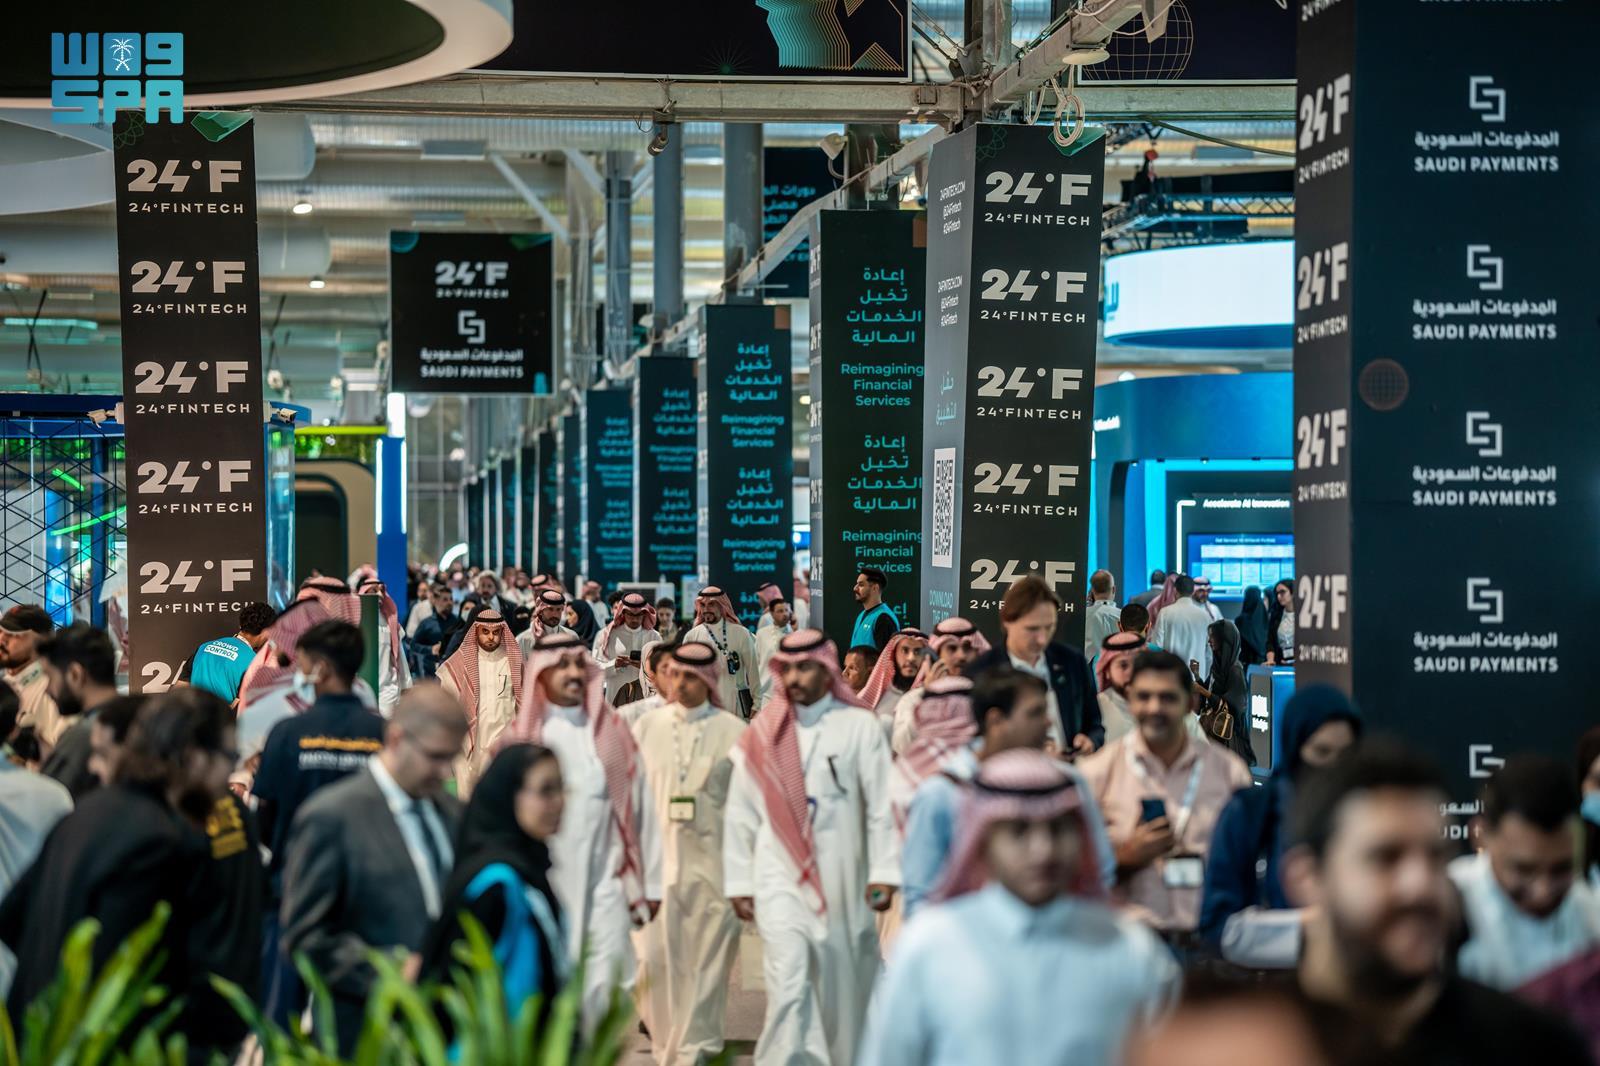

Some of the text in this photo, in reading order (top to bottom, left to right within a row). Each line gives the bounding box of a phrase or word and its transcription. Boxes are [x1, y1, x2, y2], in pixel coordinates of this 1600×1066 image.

[1299, 73, 1351, 150] 24°F
[1414, 131, 1559, 150] المدفوعات السعودية
[1414, 156, 1559, 172] SAUDI PAYMENTS
[126, 159, 242, 193] 24°F
[985, 171, 1092, 205] 24°F
[128, 202, 244, 214] 24°FINTECH
[984, 212, 1090, 226] 24°FINTECH
[130, 260, 246, 294] 24°F
[863, 267, 904, 285] إعادة
[1297, 242, 1349, 310] 24°F
[981, 268, 1087, 302] 24°F
[860, 288, 908, 305] تخيل
[132, 303, 247, 315] 24°FINTECH
[846, 309, 922, 322] الخدمات
[980, 310, 1086, 323] 24°FINTECH
[1412, 299, 1557, 319] المدفوعات السعودية
[852, 329, 915, 346] المالية
[1412, 323, 1557, 339] SAUDI PAYMENTS
[134, 361, 249, 394] 24°F
[420, 365, 524, 378] SAUDI PAYMENTS
[841, 363, 924, 377] Reimagining
[853, 379, 912, 390] Financial
[977, 365, 1083, 400] 24°F
[136, 403, 250, 414] 24°FINTECH
[855, 395, 911, 406] Services
[976, 406, 1082, 420] 24°FINTECH
[864, 435, 905, 452] إعادة
[1297, 409, 1347, 469] 24°F
[860, 456, 909, 472] تخيل
[137, 460, 252, 494] 24°F
[847, 476, 922, 489] الخدمات
[974, 462, 1079, 496] 24°F
[1412, 465, 1557, 485] المدفوعات السعودية
[853, 497, 916, 513] المالية
[1412, 490, 1557, 506] SAUDI PAYMENTS
[138, 502, 253, 514] 24°FINTECH
[973, 503, 1078, 516] 24°FINTECH
[855, 546, 913, 557] Financial
[139, 559, 254, 594] 24°F
[1298, 574, 1348, 630] 24°F
[1413, 631, 1558, 651] المدفوعات السعودية
[1413, 656, 1559, 672] SAUDI PAYMENTS
